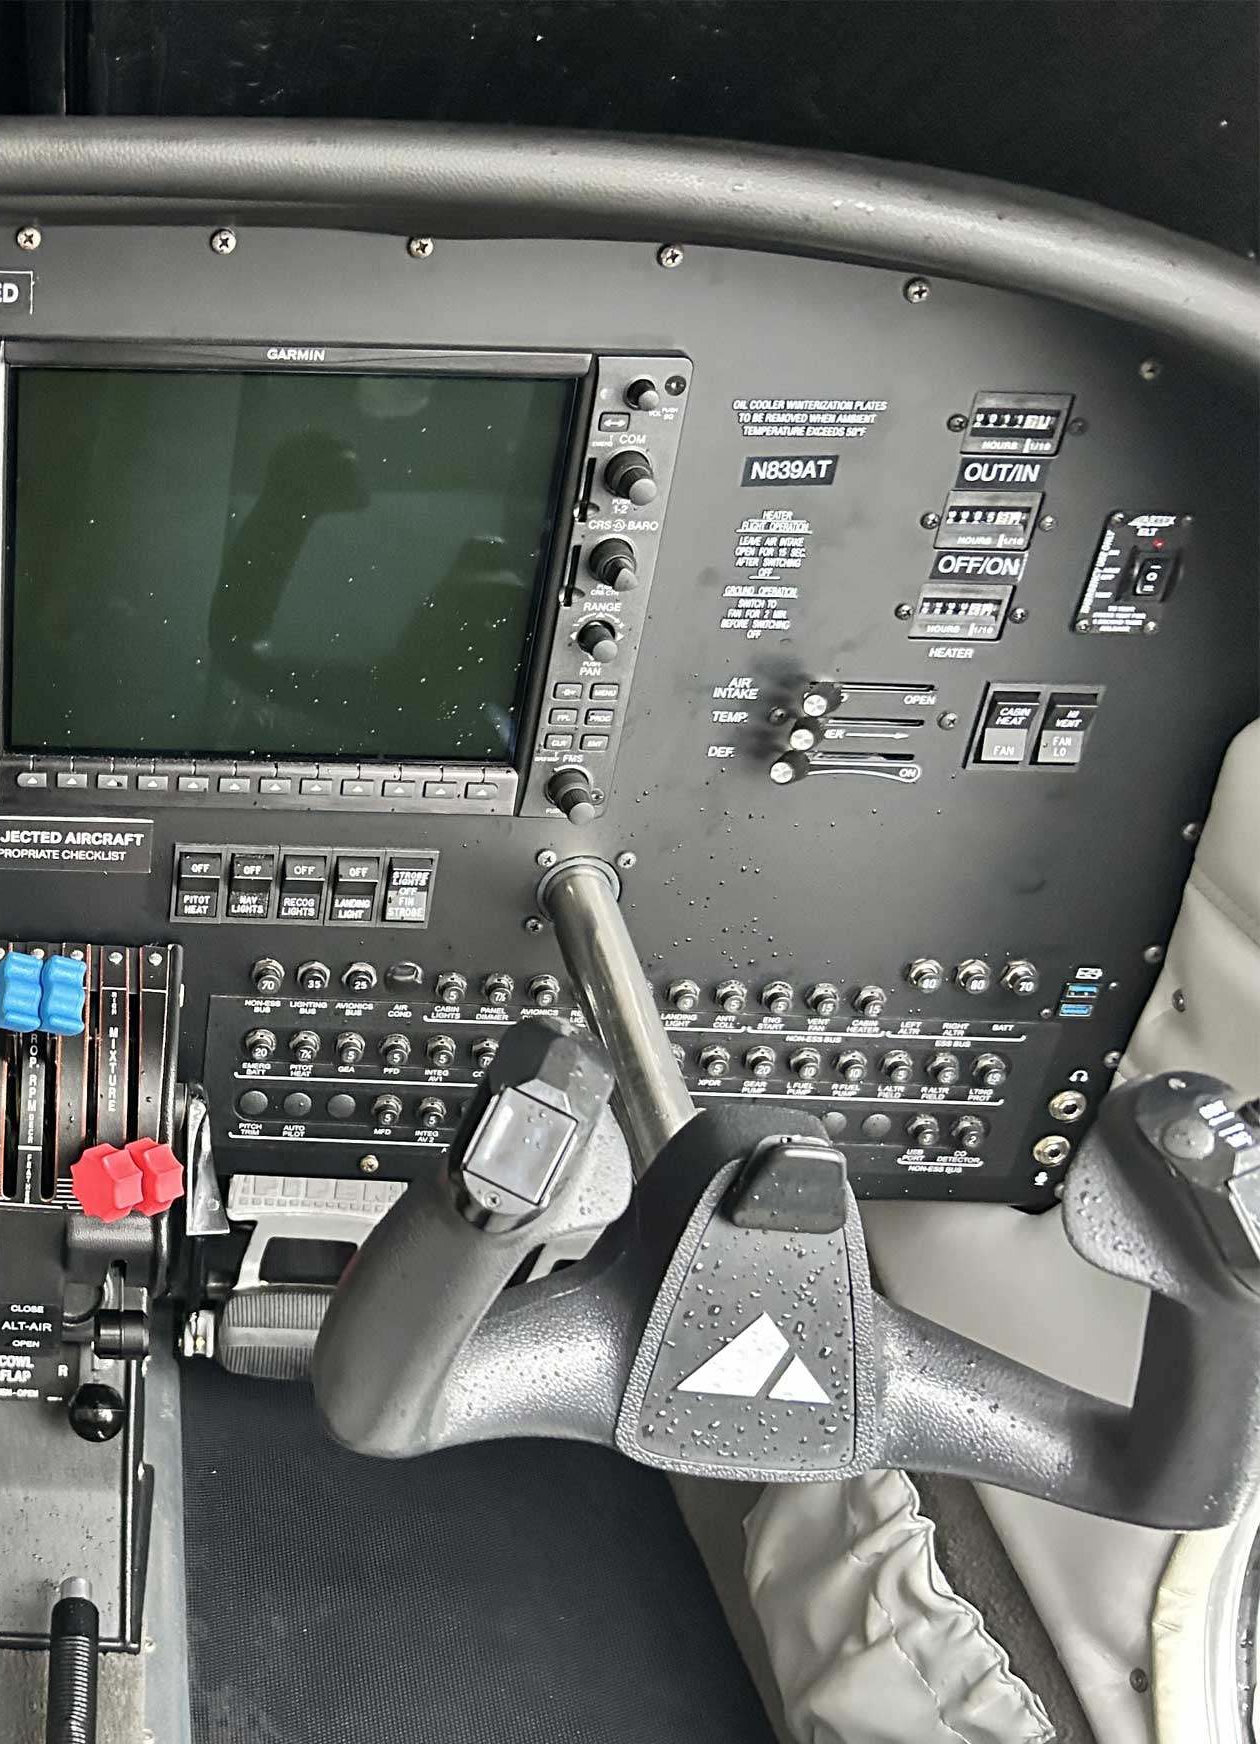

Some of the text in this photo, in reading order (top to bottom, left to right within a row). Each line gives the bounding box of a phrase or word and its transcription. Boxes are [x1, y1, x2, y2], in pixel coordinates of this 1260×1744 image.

[267, 348, 325, 361] GARMIN
[732, 400, 888, 411] OIL COOLER WINTERIZATION PLATES
[738, 413, 876, 424] TO BE REMOVED WHEN AMBIENT
[743, 426, 804, 436] TEMPERATURE
[806, 426, 845, 436] EXCEEDS
[620, 434, 646, 444] COM
[751, 460, 832, 480] N839AT
[964, 463, 1040, 482] OUT/IN
[588, 521, 658, 531] CRS BARO
[938, 555, 1020, 576] OFF/ON
[584, 602, 622, 612] RANGE
[928, 648, 974, 658] HEATER
[580, 666, 602, 676] PAN
[728, 678, 754, 688] AIR
[712, 688, 758, 700] INTAKE
[904, 694, 936, 705] OPEN
[712, 711, 748, 722] TEMP.
[1000, 708, 1032, 716] CABIN
[996, 716, 1026, 726] HEAT
[1056, 719, 1082, 728] VENT
[1052, 736, 1072, 746] FAN
[708, 747, 734, 758] DEF.
[994, 746, 1014, 756] FAN
[1054, 748, 1066, 756] LO
[562, 754, 584, 763] FMS
[899, 768, 916, 777] ON
[66, 831, 144, 846] AIRCRAFT
[62, 850, 126, 861] CHECKLIST
[192, 864, 210, 872] OFF
[244, 865, 262, 875] OFF
[294, 866, 315, 876] OFF
[349, 867, 368, 877] OFF
[184, 895, 210, 905] PITOT
[240, 896, 258, 905] NAV
[284, 897, 315, 906] RECOG
[335, 898, 370, 908] LANDING
[184, 904, 208, 914] HEAT
[232, 904, 264, 914] LIGHTS
[282, 906, 315, 916] LIGHTS
[338, 910, 364, 918] LIGHT
[262, 981, 274, 990] 70
[308, 980, 320, 988] 35
[108, 1027, 119, 1112] MIXTURE
[28, 1074, 38, 1112] RPM
[10, 1304, 44, 1314] CLOSE
[2, 1321, 52, 1332] ALT-AIR
[12, 1340, 40, 1348] OPEN
[58, 1365, 68, 1376] R
[0, 1370, 32, 1382] FLAP
